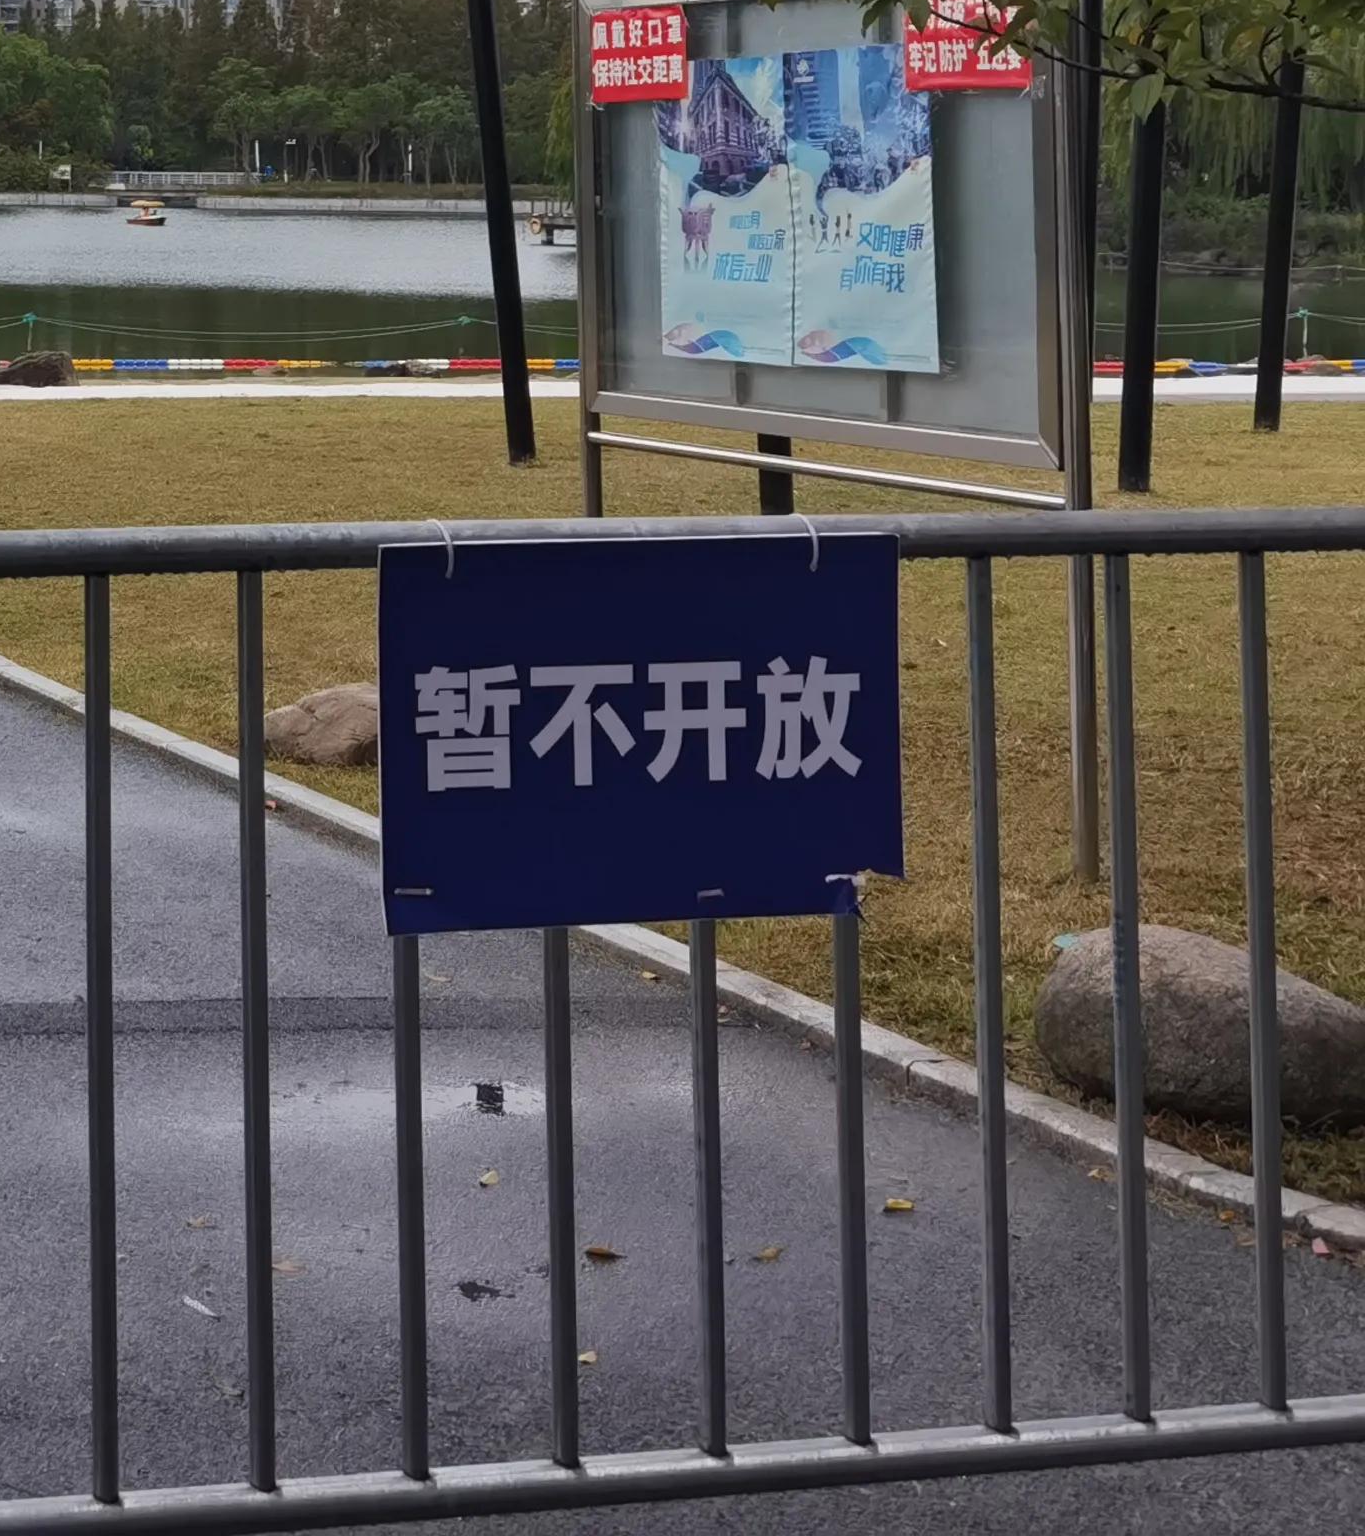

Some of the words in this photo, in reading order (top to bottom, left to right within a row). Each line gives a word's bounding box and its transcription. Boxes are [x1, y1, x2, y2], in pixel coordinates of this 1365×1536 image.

[592, 15, 683, 50] 佩戴好口罩
[592, 54, 684, 88] 保持社交距离
[855, 222, 925, 258] 文明健康
[712, 252, 773, 282] 诚信立业
[839, 255, 905, 293] 有你有我
[414, 655, 864, 792] 暂不开放
